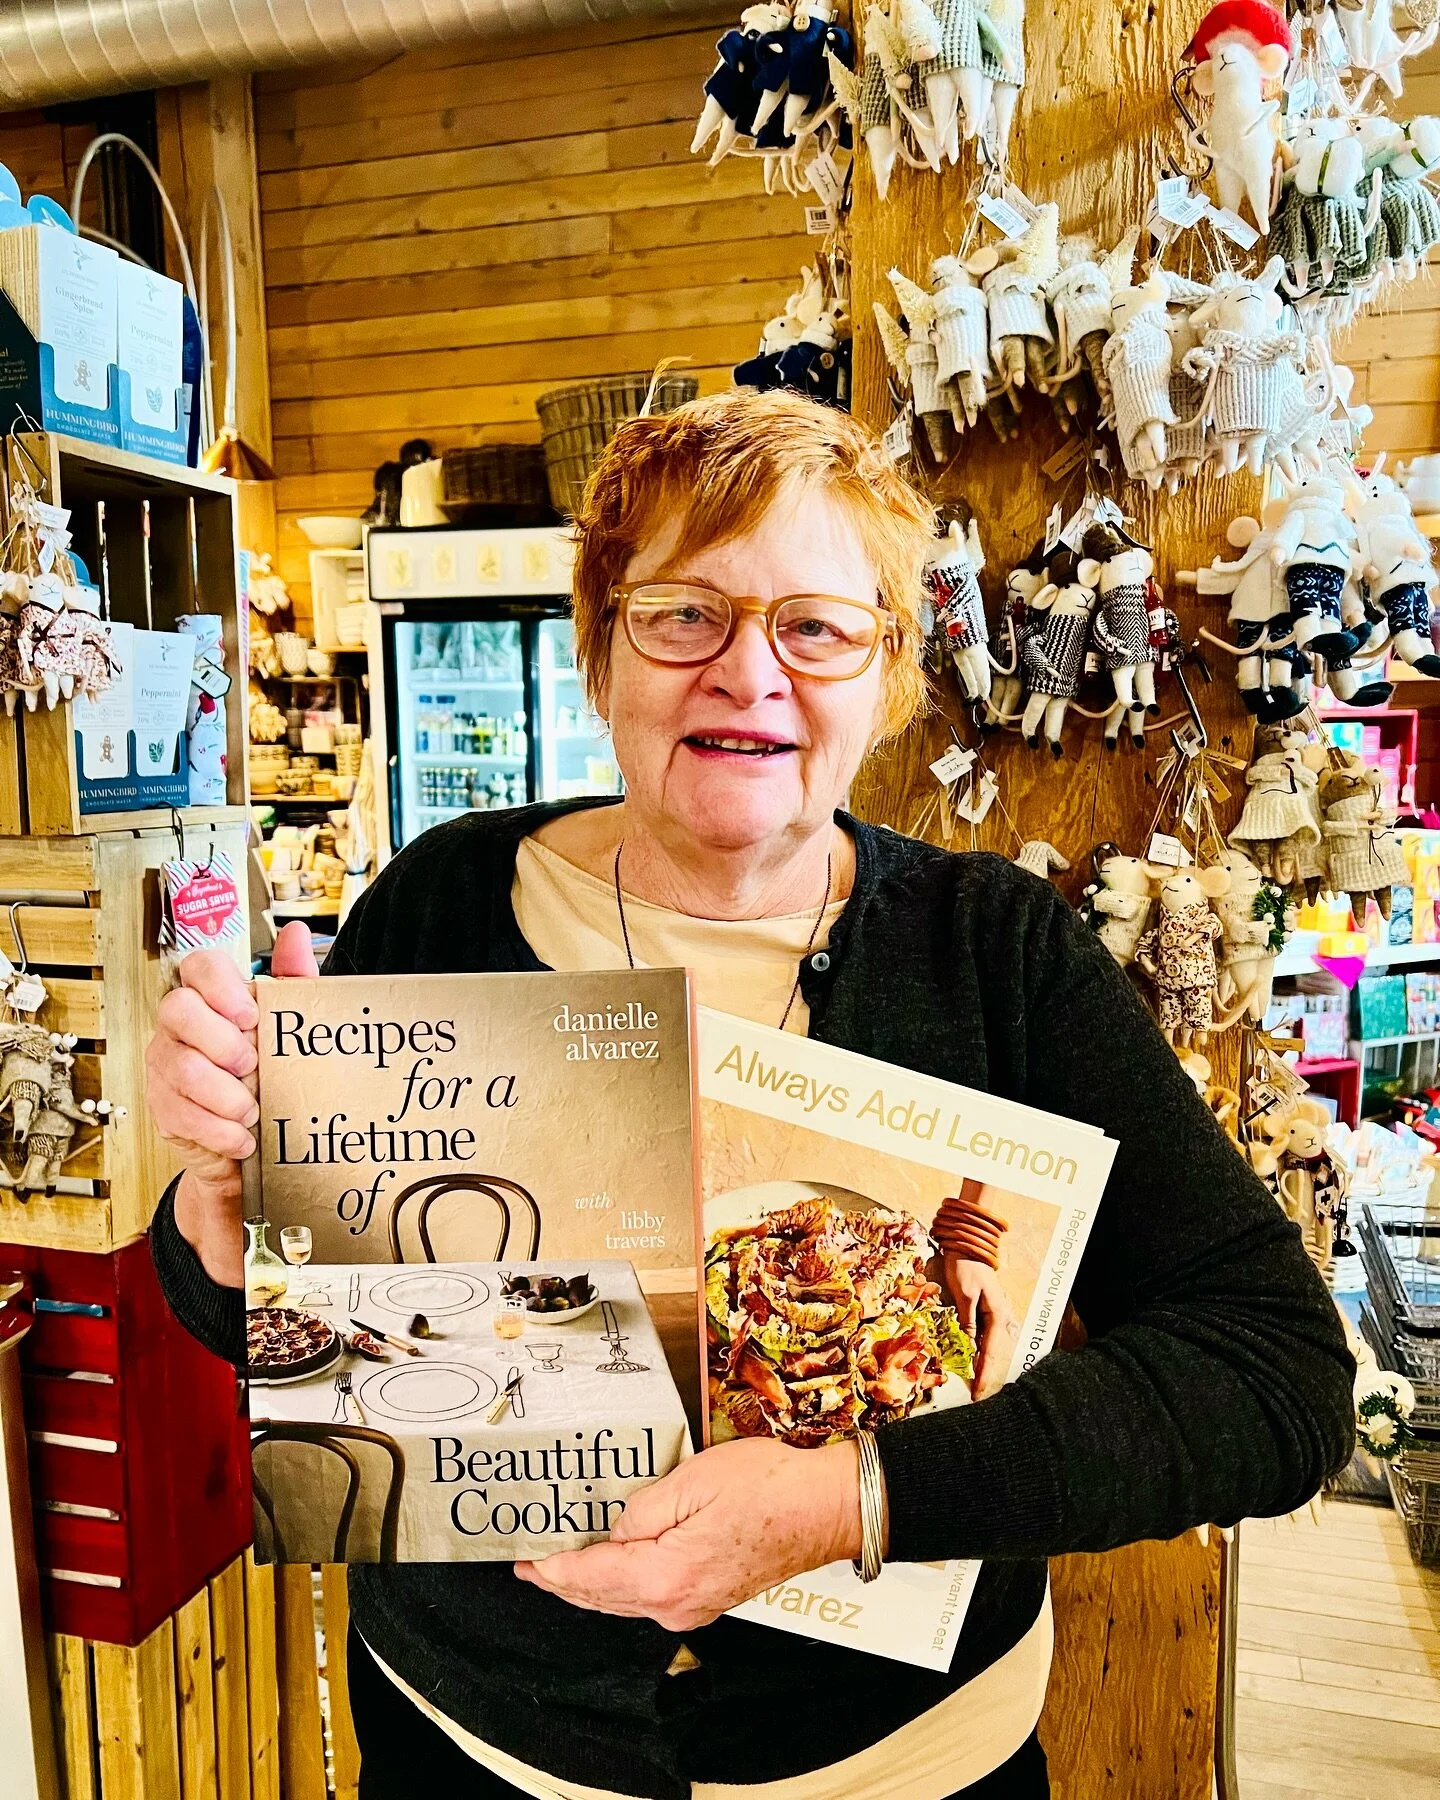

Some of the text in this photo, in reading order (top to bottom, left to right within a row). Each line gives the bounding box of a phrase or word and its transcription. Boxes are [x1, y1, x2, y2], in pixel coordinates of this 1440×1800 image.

[46, 408, 119, 434] HUMMINGBIRD
[124, 431, 186, 453] HUMMINGBIRD
[141, 687, 181, 698] Peppermint
[142, 784, 188, 795] MMINGBIRD
[177, 898, 208, 915] SUGAR
[209, 891, 236, 907] SAVER
[553, 1001, 659, 1033] danielle
[270, 1006, 457, 1069] Recipes
[565, 1034, 660, 1061] alvarez
[386, 1057, 519, 1123] for a
[714, 1044, 1078, 1185] Always Add Lemon
[272, 1113, 477, 1165] Lifetime
[336, 1170, 396, 1236] of
[574, 1191, 612, 1210] with
[620, 1210, 666, 1233] libby
[605, 1233, 666, 1250] travers
[1020, 1208, 1087, 1375] Recipes you want to co
[428, 1427, 660, 1483] Beautiful
[450, 1483, 627, 1536] Cookin
[752, 1583, 864, 1630] varez
[945, 1572, 966, 1612] want
[940, 1610, 955, 1625] to
[932, 1627, 947, 1651] eat
